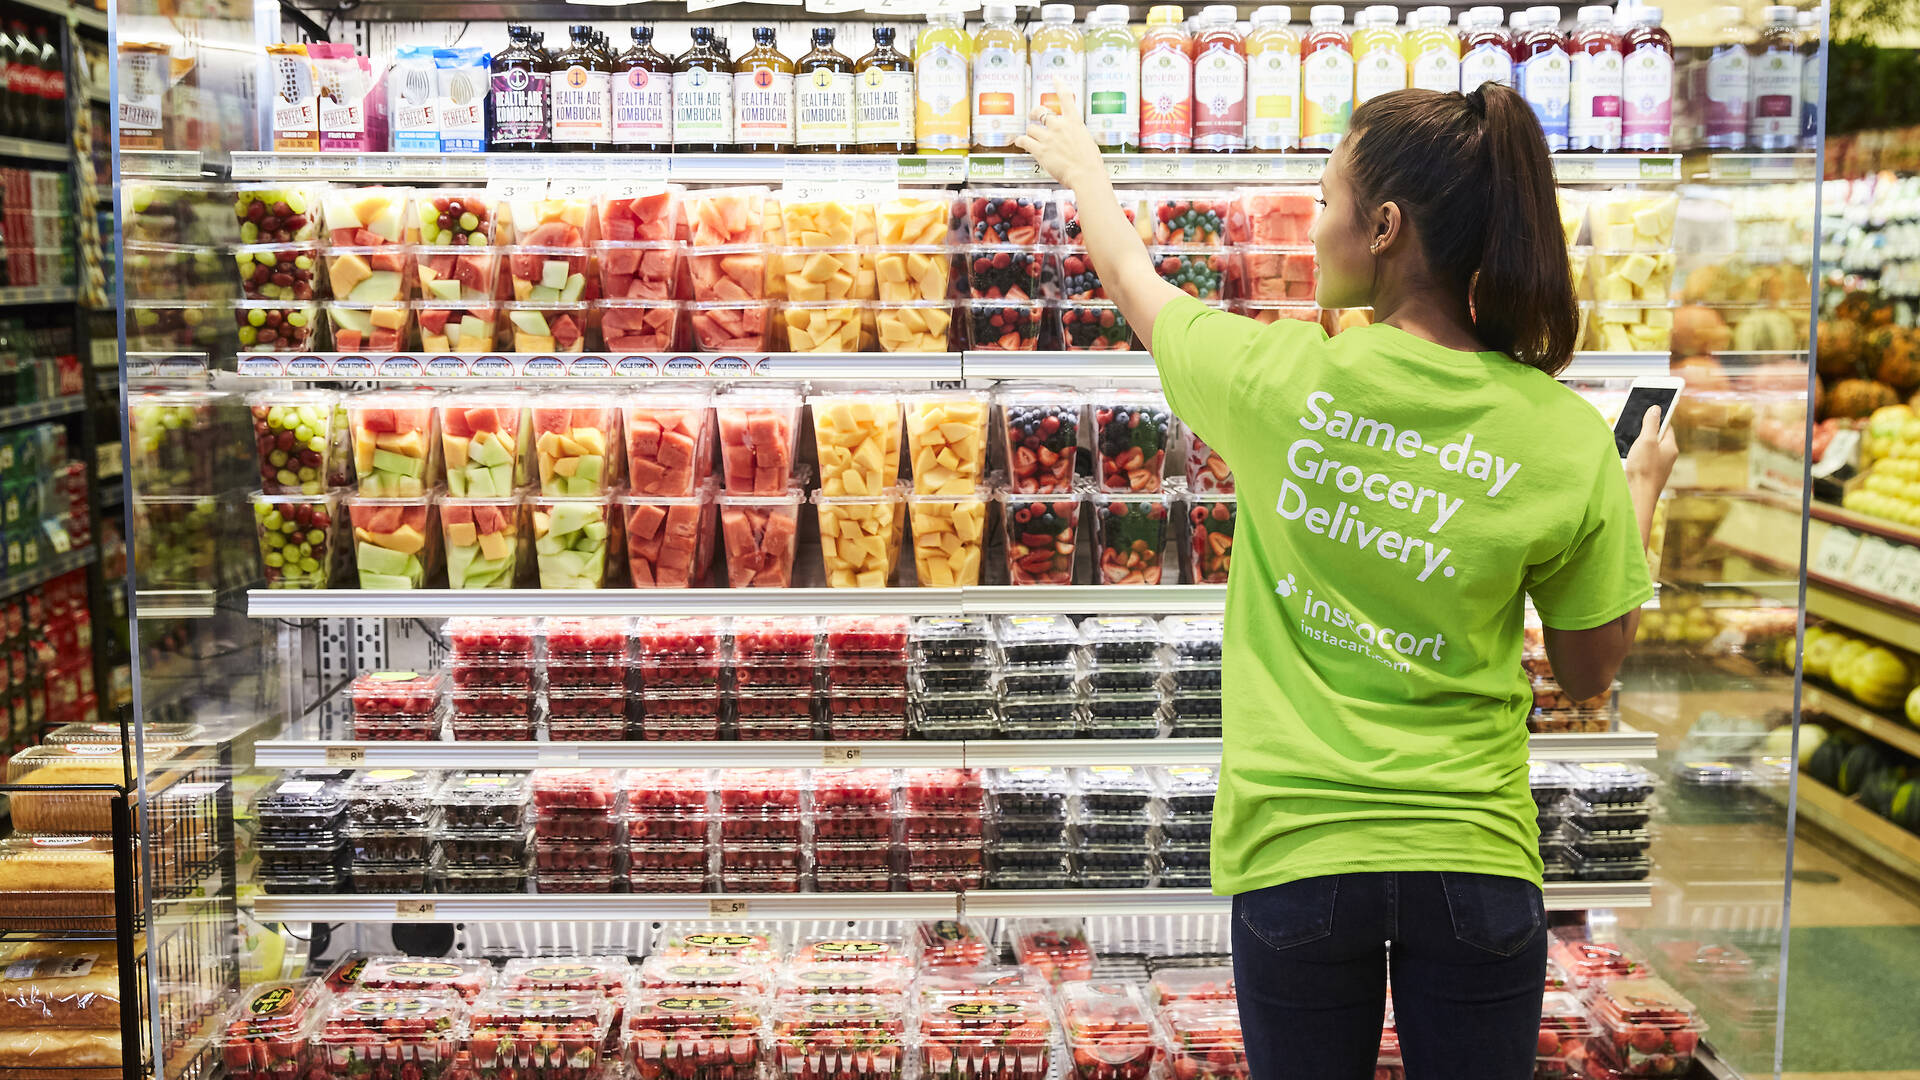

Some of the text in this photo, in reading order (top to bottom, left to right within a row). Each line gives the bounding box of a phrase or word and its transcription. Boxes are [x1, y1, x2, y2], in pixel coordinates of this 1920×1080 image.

[496, 106, 544, 122] KOMBUCHA
[556, 106, 601, 120] KOMBUCHA
[618, 107, 662, 121] KOMBUCHA
[678, 108, 721, 122] KOMBUCHA
[742, 108, 786, 122] KOMBUCHA
[802, 108, 846, 122] KOMBUCHA
[858, 106, 898, 121] KOMBUCHA
[898, 164, 926, 176] rganic
[972, 162, 1003, 175] Organic
[1299, 391, 1522, 498] Same-day
[1287, 439, 1464, 534] Grocery
[1276, 478, 1456, 582] Delivery.
[1303, 589, 1446, 662] instacart
[1301, 620, 1410, 673] instacart.com
